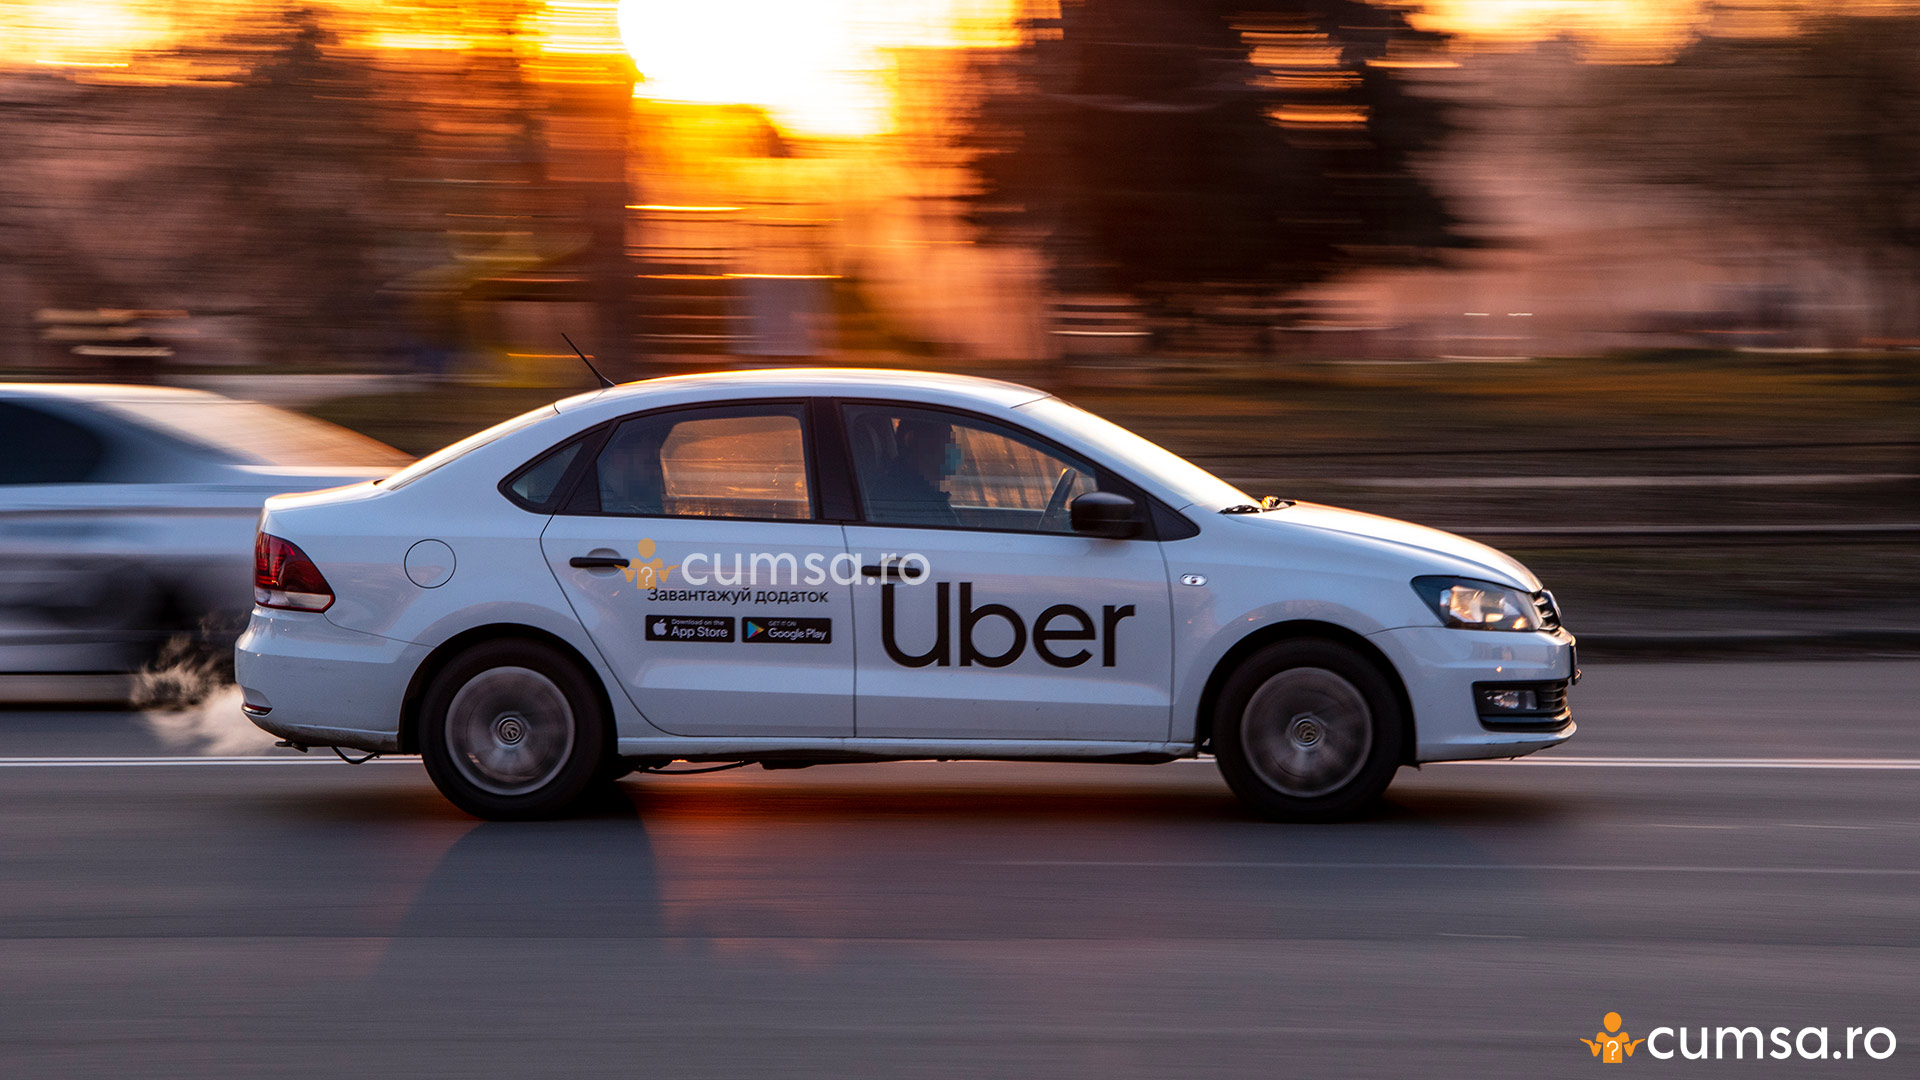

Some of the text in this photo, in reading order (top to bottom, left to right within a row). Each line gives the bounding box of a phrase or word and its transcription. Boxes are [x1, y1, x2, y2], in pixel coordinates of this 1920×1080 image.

[647, 587, 829, 606] Завантажуй додаток
[670, 625, 729, 638] App Store
[881, 582, 1136, 669] Uber
[767, 627, 828, 641] Google Play
